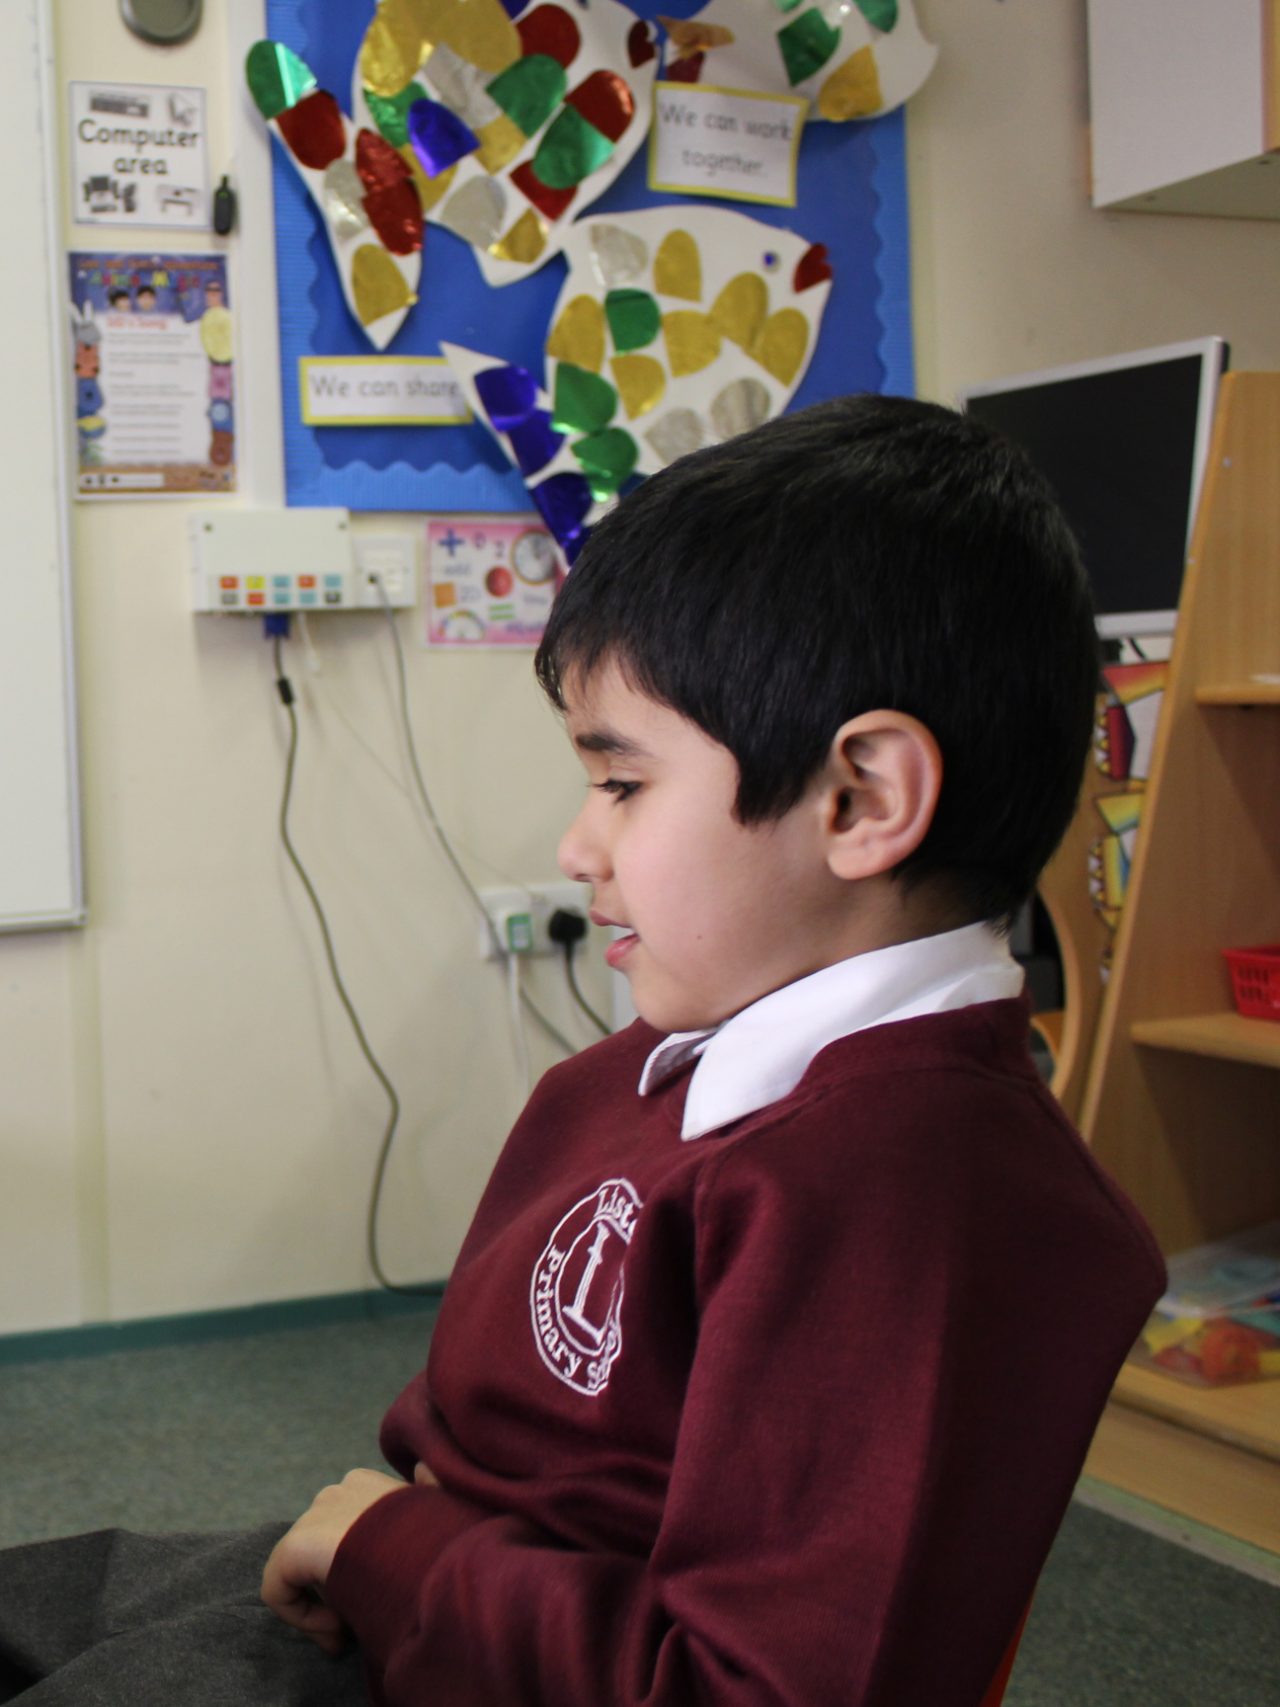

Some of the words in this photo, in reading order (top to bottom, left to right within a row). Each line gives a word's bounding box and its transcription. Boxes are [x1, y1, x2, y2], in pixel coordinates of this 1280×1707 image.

[78, 118, 200, 154] Computer
[659, 103, 696, 127] We
[703, 112, 739, 132] can
[745, 118, 793, 141] work
[113, 157, 167, 175] area
[310, 374, 351, 396] We
[358, 379, 399, 396] can
[537, 1244, 582, 1377] Primary
